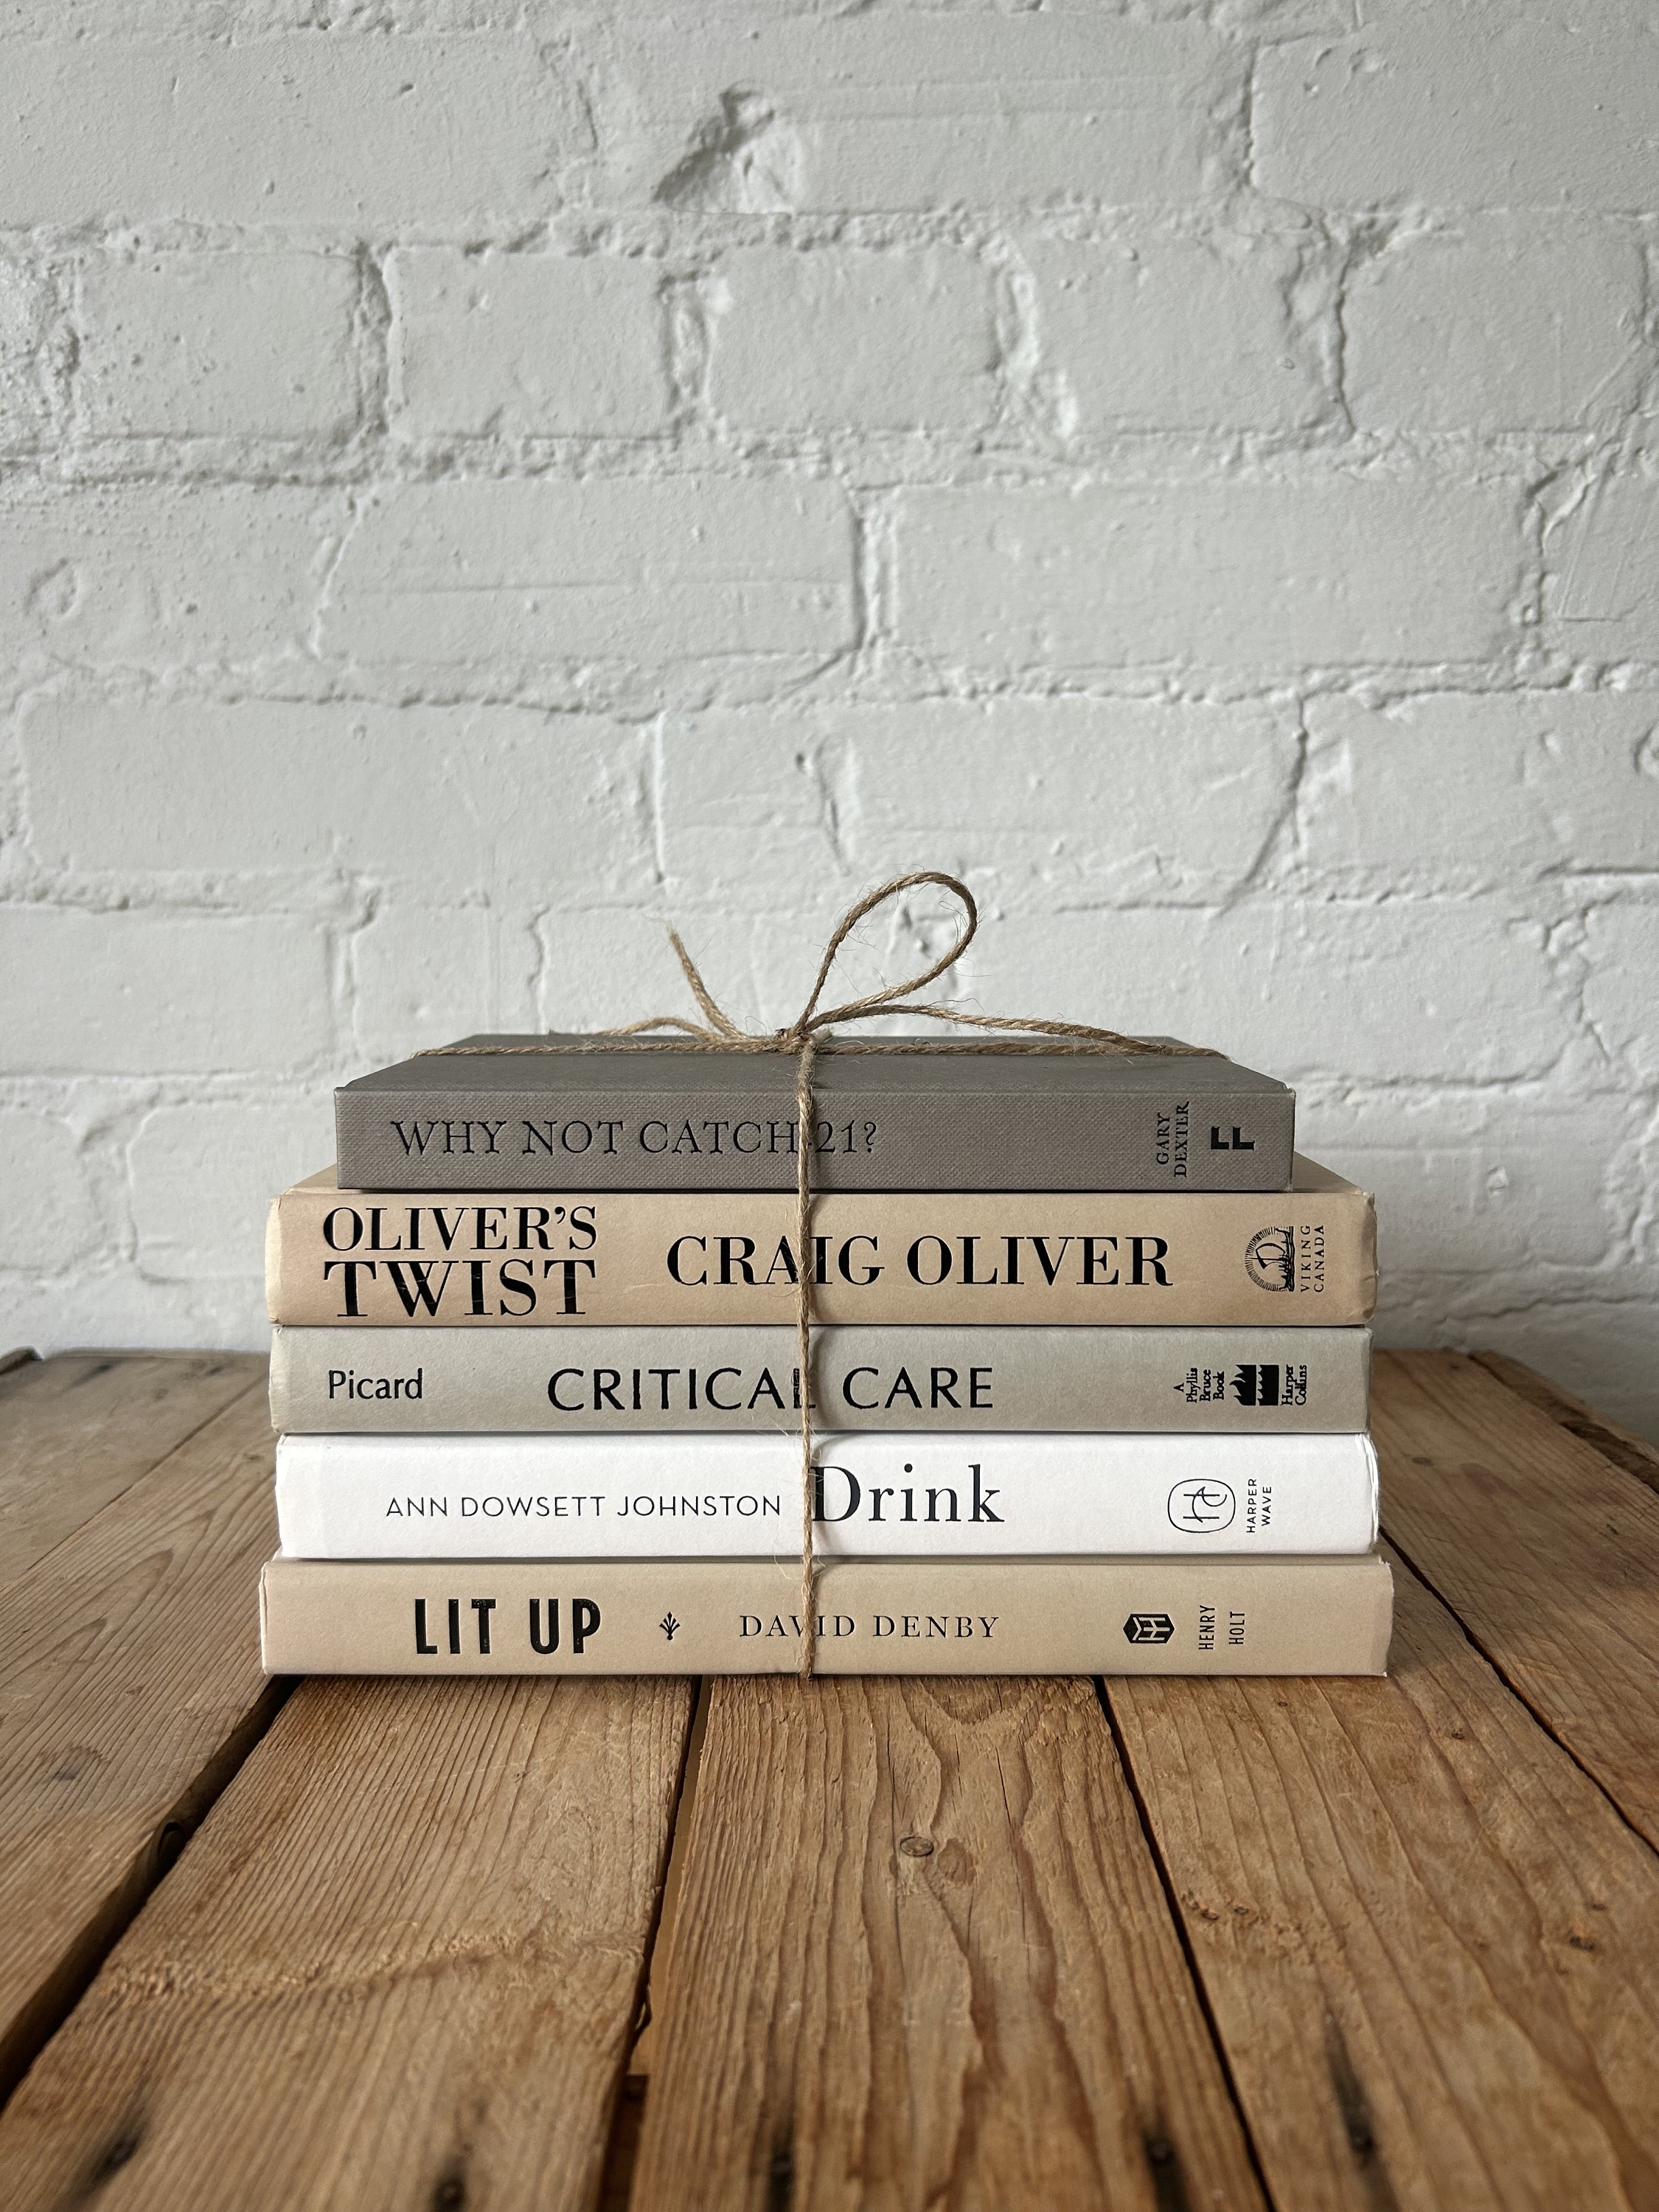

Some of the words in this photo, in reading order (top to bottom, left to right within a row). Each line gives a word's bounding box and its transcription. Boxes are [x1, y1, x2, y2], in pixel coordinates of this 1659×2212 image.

[390, 1120, 507, 1156] WHY
[521, 1120, 624, 1156] NOT
[1155, 1112, 1170, 1165] GARY
[1173, 1101, 1190, 1178] DEXTER
[323, 1206, 597, 1251] OLIVER’S
[667, 1235, 886, 1286] CRAIG
[907, 1235, 1174, 1287] OLIVER
[1300, 1225, 1312, 1293] VIKING
[1313, 1225, 1325, 1293] CANADA
[324, 1259, 596, 1318] TWIST
[328, 1367, 422, 1399] Picard
[547, 1367, 816, 1411] CRITICAL
[842, 1366, 993, 1410] CARE
[1173, 1382, 1184, 1393] A
[1186, 1367, 1201, 1403] Phyllis
[1199, 1368, 1211, 1402] Bruce
[1212, 1371, 1225, 1400] Book
[1281, 1364, 1295, 1406] Harper
[1295, 1365, 1307, 1406] Collins
[386, 1497, 448, 1517] ANN
[461, 1496, 605, 1517] DOWSETT
[617, 1495, 780, 1516] JOHNSTON
[810, 1463, 1005, 1523] Drink
[1246, 1478, 1257, 1533] HARPER
[1261, 1486, 1272, 1526] WAVE
[414, 1599, 496, 1655] LIT
[529, 1598, 601, 1655] UP
[872, 1615, 999, 1638] DENBY
[1198, 1604, 1215, 1650] HENRY
[1228, 1611, 1245, 1645] HOLT
